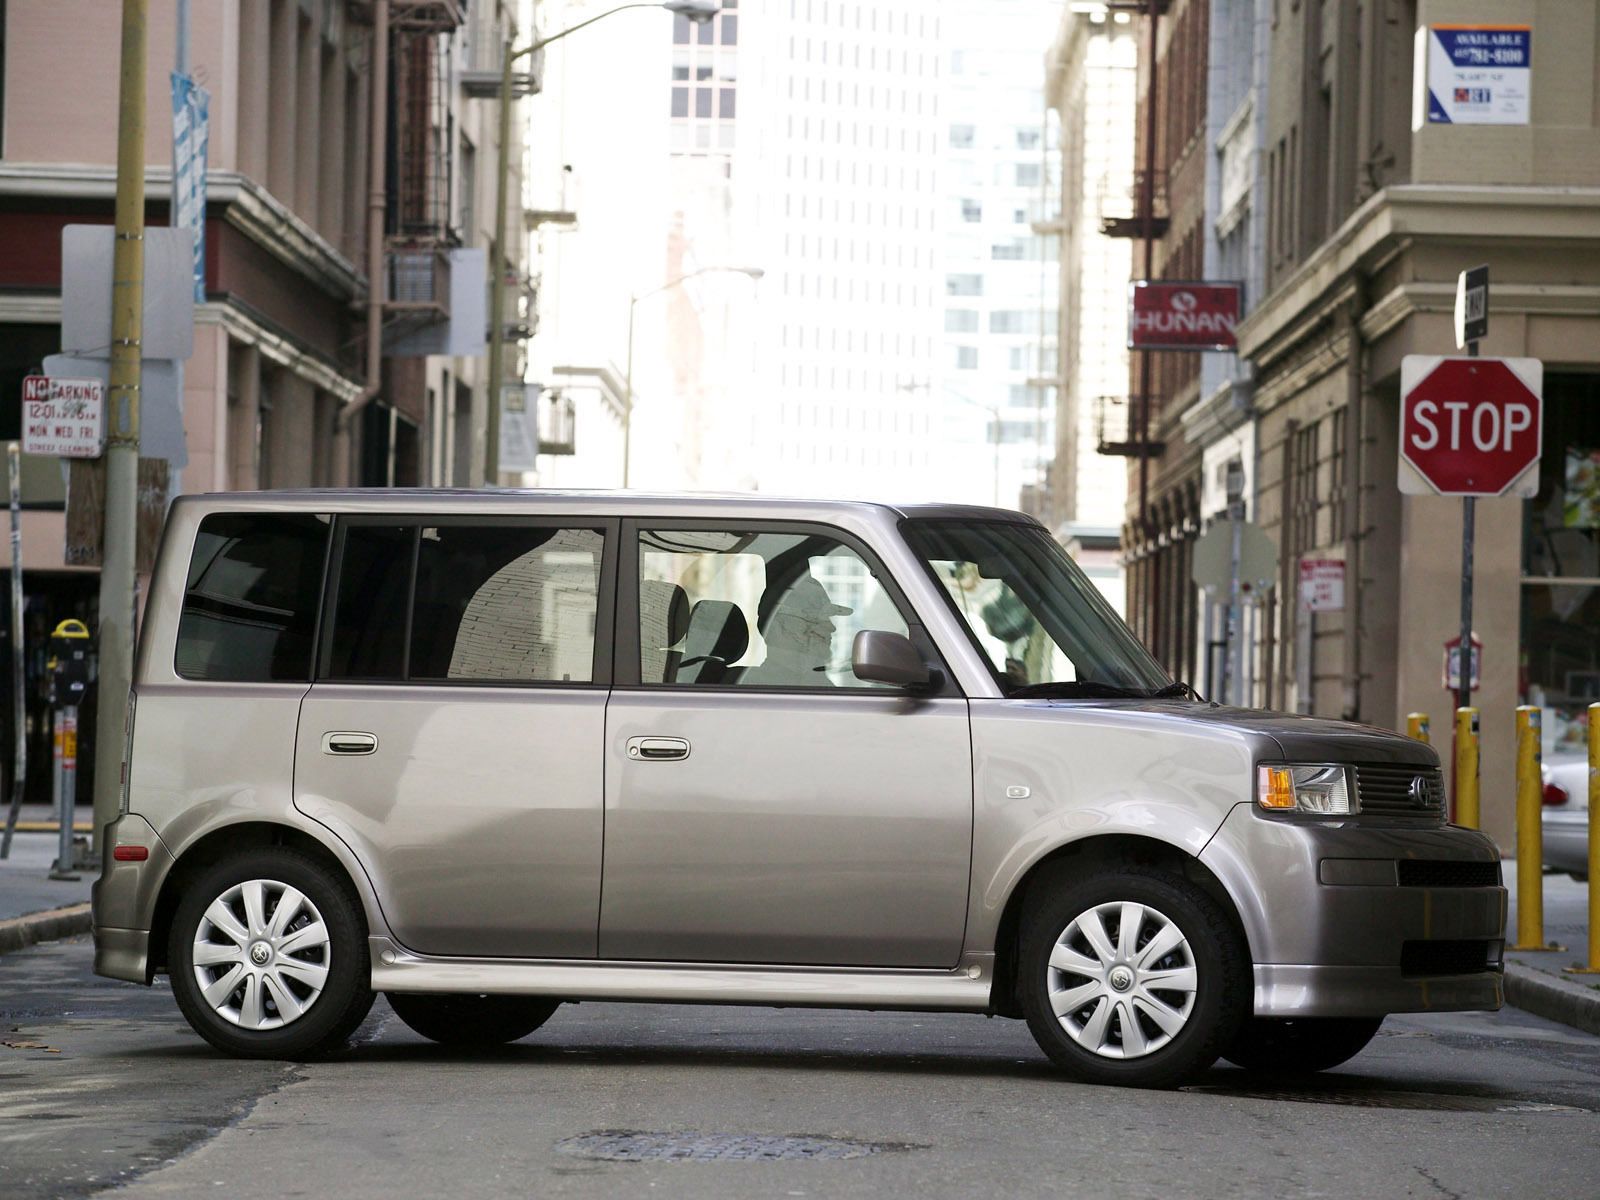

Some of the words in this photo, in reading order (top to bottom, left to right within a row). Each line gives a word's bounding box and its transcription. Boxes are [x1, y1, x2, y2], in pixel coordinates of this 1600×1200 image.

[1455, 34, 1522, 46] AVAILABLE
[1133, 311, 1236, 333] HUNAN
[27, 379, 47, 400] NO
[29, 425, 48, 438] MON
[55, 425, 73, 438] WED
[80, 426, 94, 438] FRI
[1411, 400, 1532, 453] STOP
